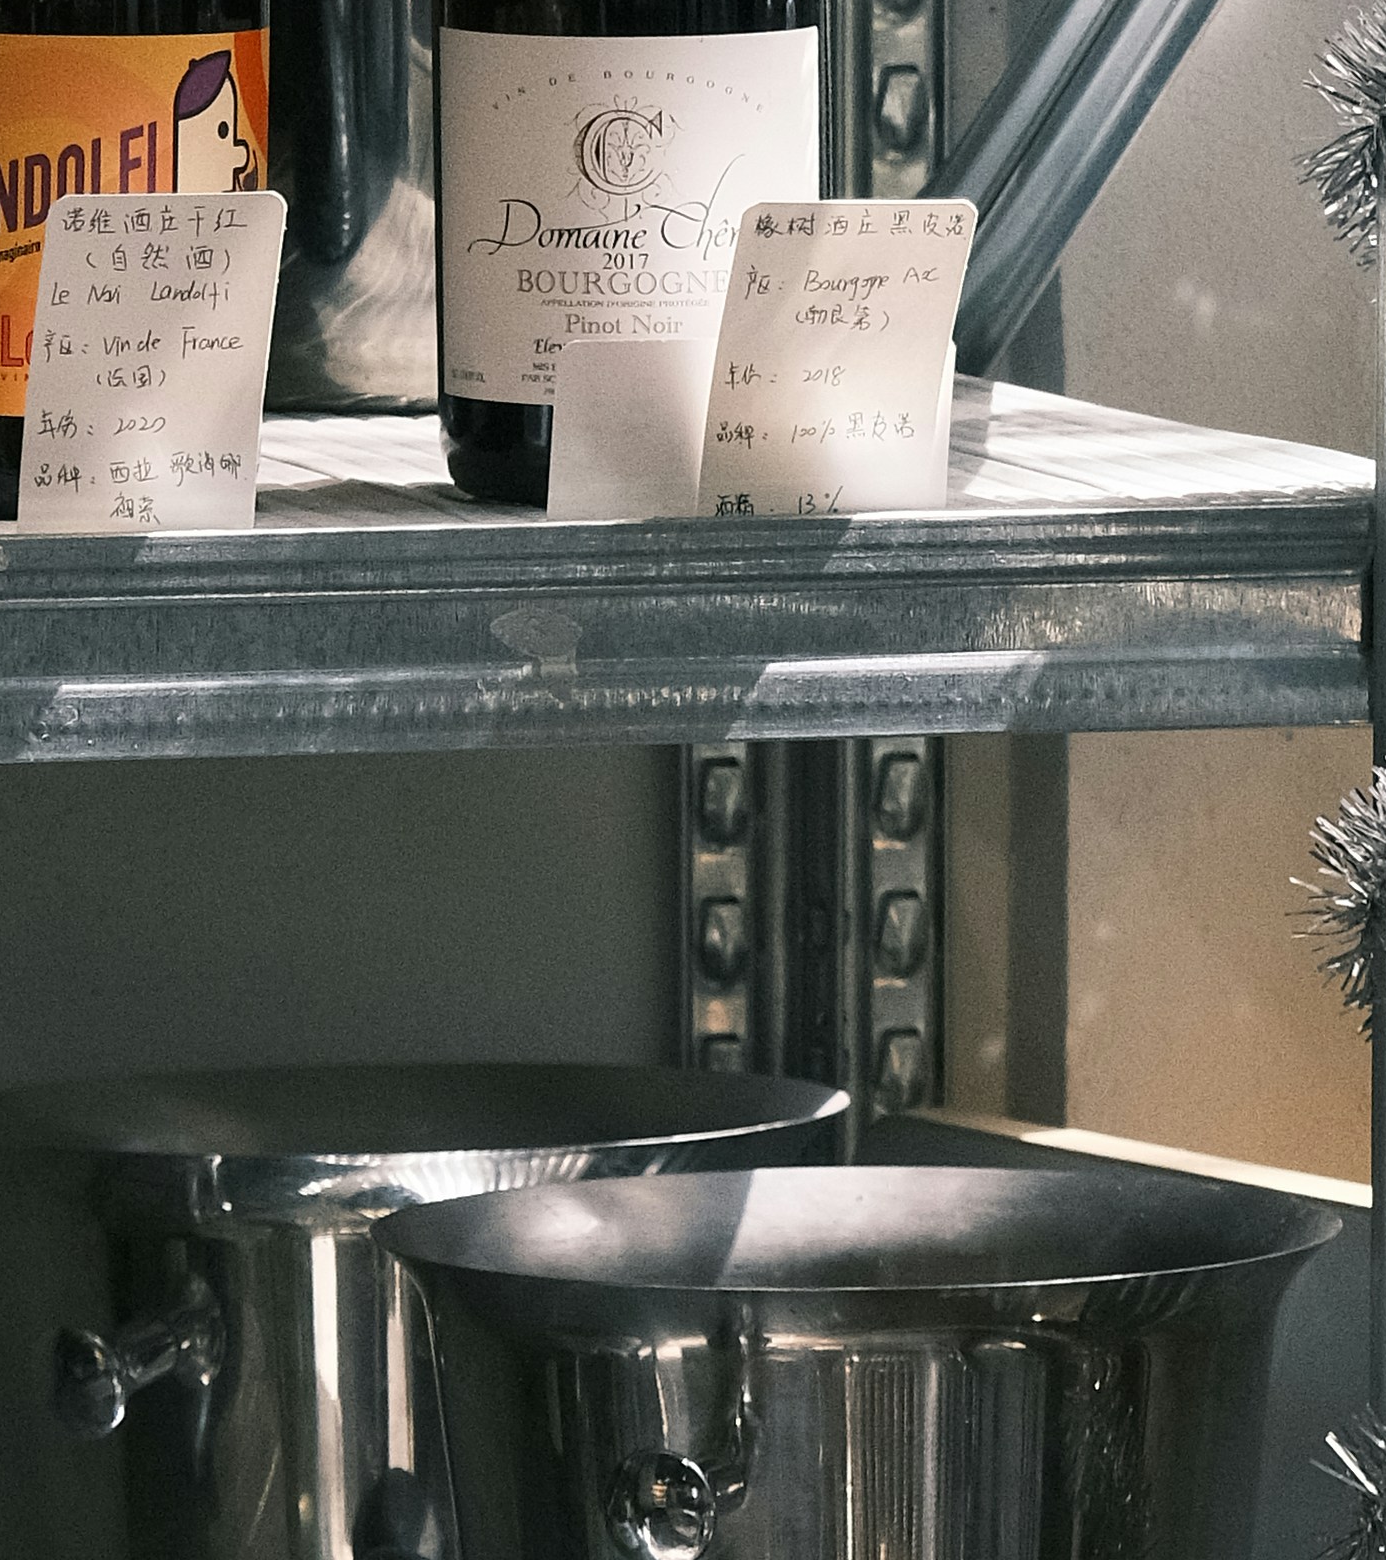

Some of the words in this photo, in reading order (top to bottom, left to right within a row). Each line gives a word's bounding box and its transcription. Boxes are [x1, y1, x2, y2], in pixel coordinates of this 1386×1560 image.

[602, 70, 765, 114] BOURGOGNE
[468, 198, 647, 256] Domaine
[602, 252, 650, 271] 2017
[50, 282, 71, 306] Le
[516, 268, 729, 297] BOURGOGNE
[564, 313, 623, 335] Pinot
[631, 313, 684, 335] Noir
[180, 326, 245, 359] France
